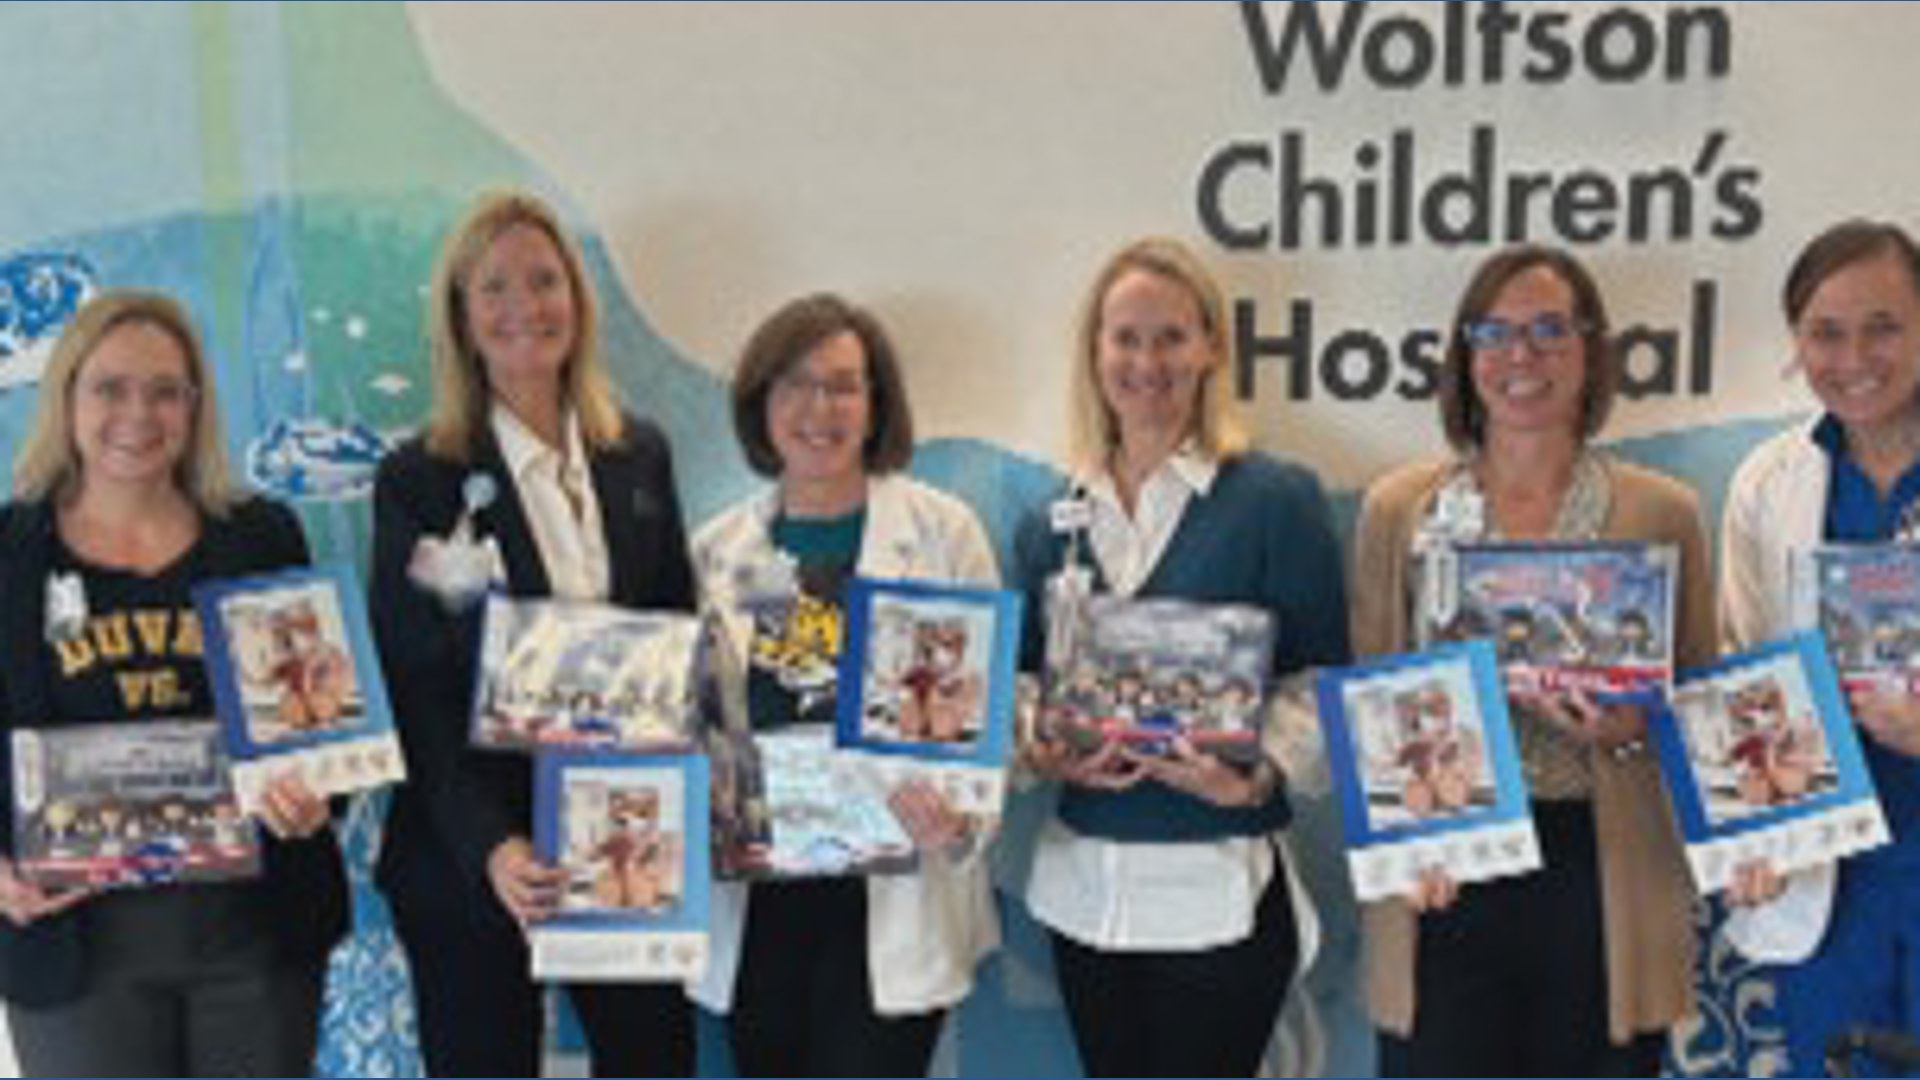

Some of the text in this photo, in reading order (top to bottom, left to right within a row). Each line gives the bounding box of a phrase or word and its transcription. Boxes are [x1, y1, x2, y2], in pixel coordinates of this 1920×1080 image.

[1238, 1, 1731, 95] Wolfson
[1196, 126, 1764, 251] Children's
[1234, 279, 1716, 401] Hosal
